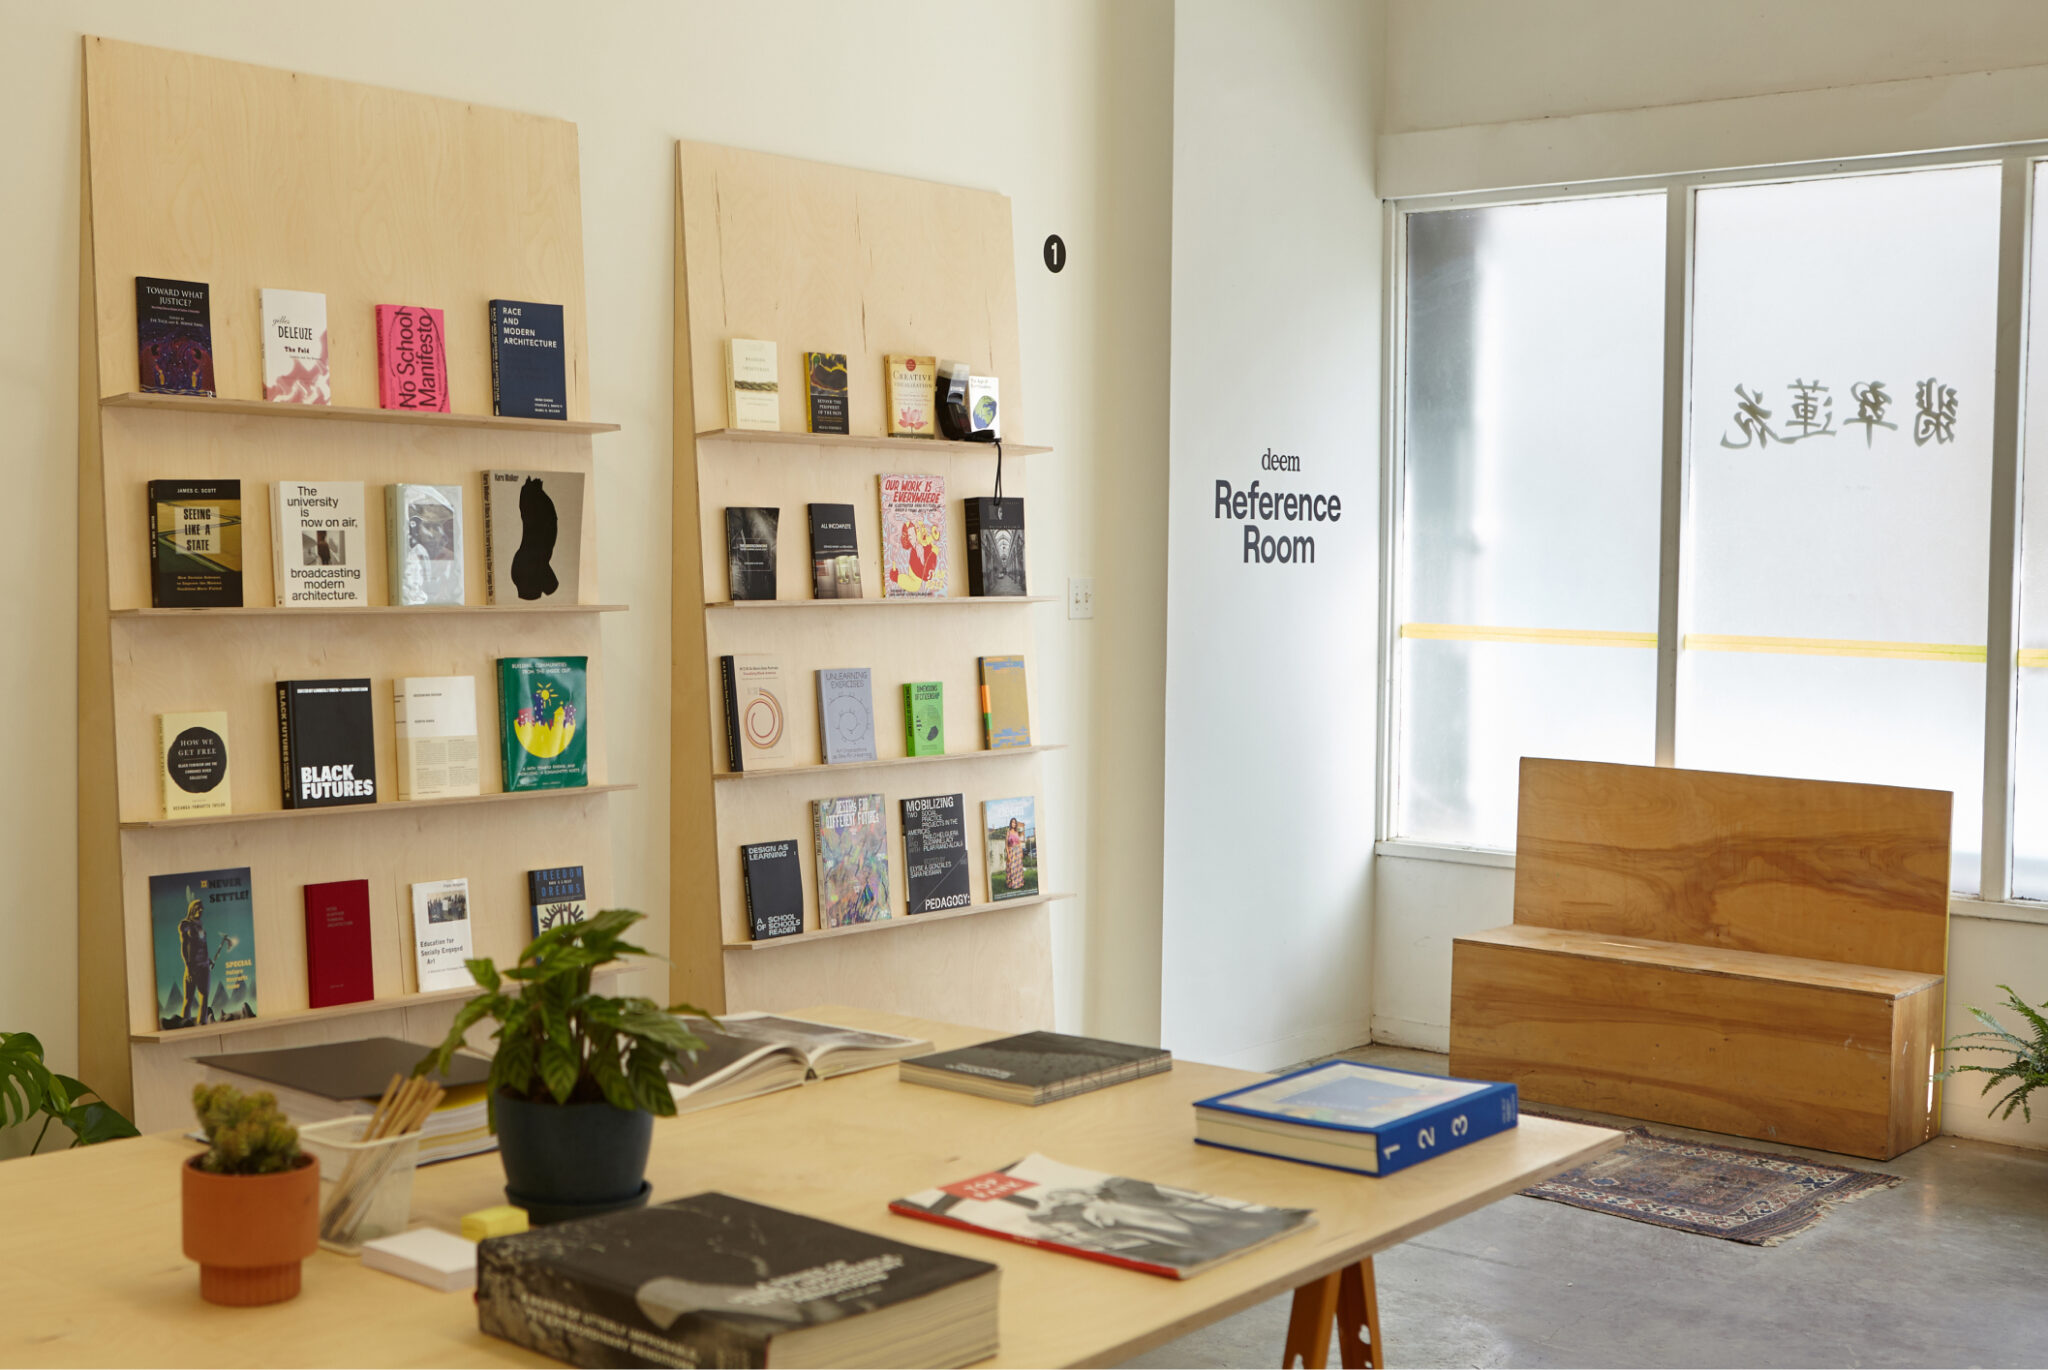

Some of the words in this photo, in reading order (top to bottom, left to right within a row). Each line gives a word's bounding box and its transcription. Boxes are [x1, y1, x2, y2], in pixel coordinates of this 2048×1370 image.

[1051, 242, 1057, 265] 1
[146, 286, 180, 297] TOWARD
[181, 290, 204, 300] WHAT
[160, 297, 192, 307] JUSTICE?
[502, 307, 522, 316] RACE
[503, 317, 519, 325] AND
[278, 326, 312, 341] DELEUZE
[504, 327, 536, 336] MODERN
[394, 311, 416, 376] School
[504, 338, 557, 348] ARCHITECTURE
[416, 315, 437, 407] Manifesto
[892, 370, 932, 381] CREATIVE
[399, 381, 417, 408] No
[1261, 448, 1301, 472] deem
[297, 486, 317, 496] The
[885, 480, 899, 491] OUR
[901, 481, 921, 492] WORK
[924, 481, 932, 493] IS
[893, 491, 941, 503] EVERYWHERE
[1215, 479, 1342, 522] Reference
[287, 497, 338, 509] university
[183, 509, 211, 520] SEEING
[301, 508, 309, 517] is
[301, 519, 323, 527] now
[325, 519, 339, 527] on
[342, 517, 358, 528] air.
[185, 524, 200, 535] LIKE
[205, 524, 211, 535] A
[187, 540, 209, 551] STATE
[1243, 525, 1315, 564] Room
[291, 568, 360, 579] broadcasting
[304, 580, 344, 589] modern
[292, 591, 358, 601] architecture.
[826, 671, 868, 681] UNLEARNING
[830, 680, 864, 689] EXERCISES
[181, 739, 199, 747] HOW
[301, 764, 354, 783] BLACK
[302, 779, 374, 800] FUTURES
[906, 797, 954, 812] MOBILIZING
[748, 846, 776, 854] DESIGN
[749, 851, 787, 861] LEARNING
[208, 877, 241, 888] NEVER
[541, 883, 580, 896] DREAMS
[209, 890, 249, 903] SETTLE!
[925, 893, 971, 910] PEDAGOGY:
[768, 914, 796, 923] SCHOOL
[757, 924, 767, 932] OF
[768, 919, 800, 930] SCHOOLS
[768, 926, 796, 936] READER
[420, 939, 445, 948] Education
[225, 959, 252, 969] SPECIAL
[1383, 1144, 1400, 1160] 1
[1418, 1126, 1436, 1149] 2
[1452, 1115, 1468, 1136] 3
[964, 1178, 997, 1192] TOP
